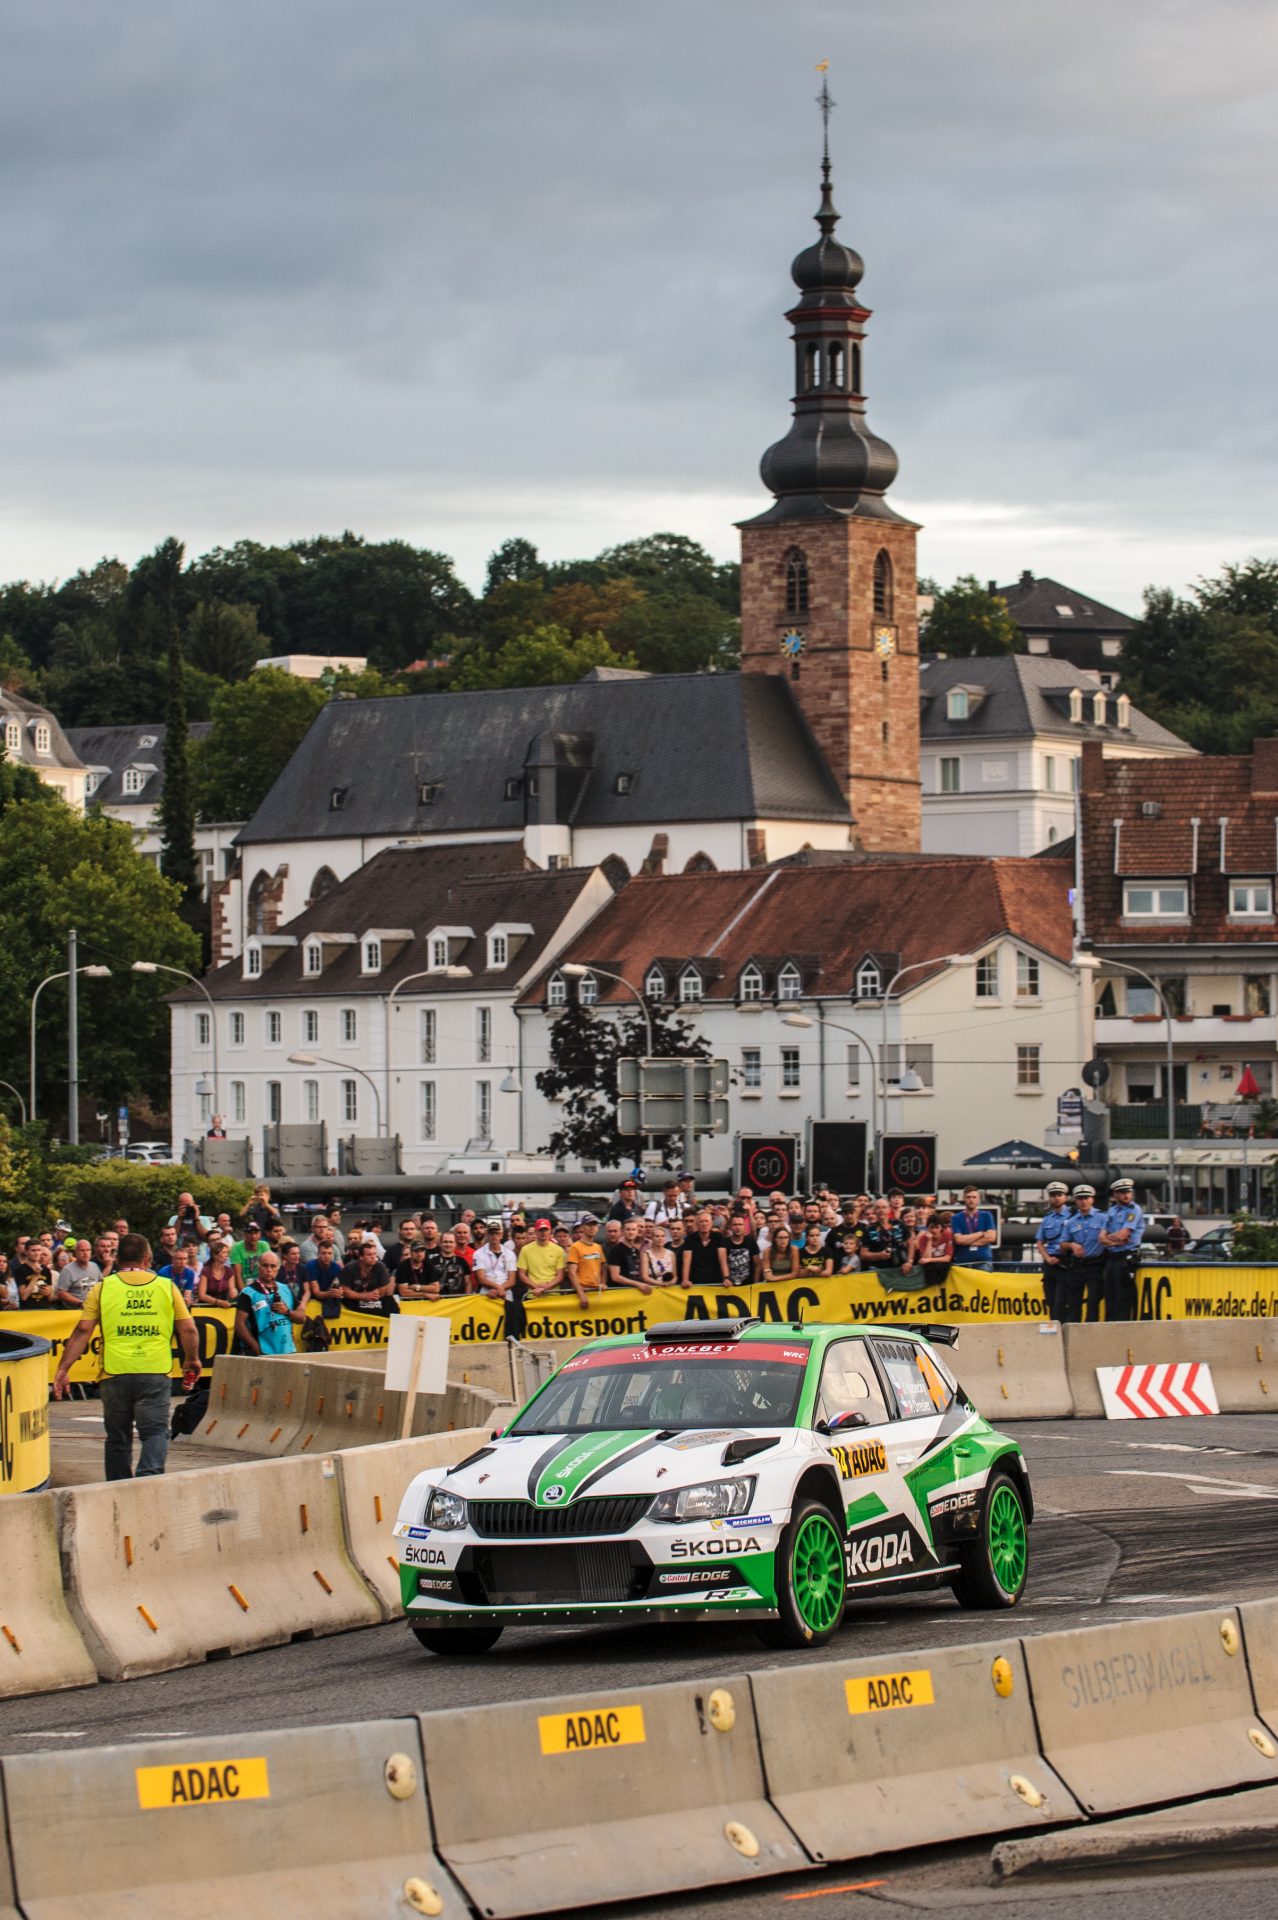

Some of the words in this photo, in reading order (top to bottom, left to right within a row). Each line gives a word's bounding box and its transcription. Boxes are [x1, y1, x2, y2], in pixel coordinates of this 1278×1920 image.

[757, 1157, 781, 1177] 80
[899, 1156, 922, 1175] 80
[126, 1299, 152, 1309] ADAC
[117, 1325, 160, 1336] MARSHAL
[662, 1345, 738, 1354] ONEBET
[783, 1350, 806, 1359] WRC
[851, 1440, 886, 1475] ADAC
[944, 1493, 977, 1511] EDGE
[732, 1516, 771, 1526] MICHELIN
[405, 1544, 446, 1565] ŠKODA
[670, 1538, 762, 1557] ŠKODA
[432, 1580, 453, 1589] EDGE
[690, 1571, 731, 1582] EDGE
[704, 1588, 751, 1601] R5
[868, 1676, 913, 1710] ADAC
[566, 1712, 621, 1749] ADAC
[172, 1765, 240, 1803] ADAC
